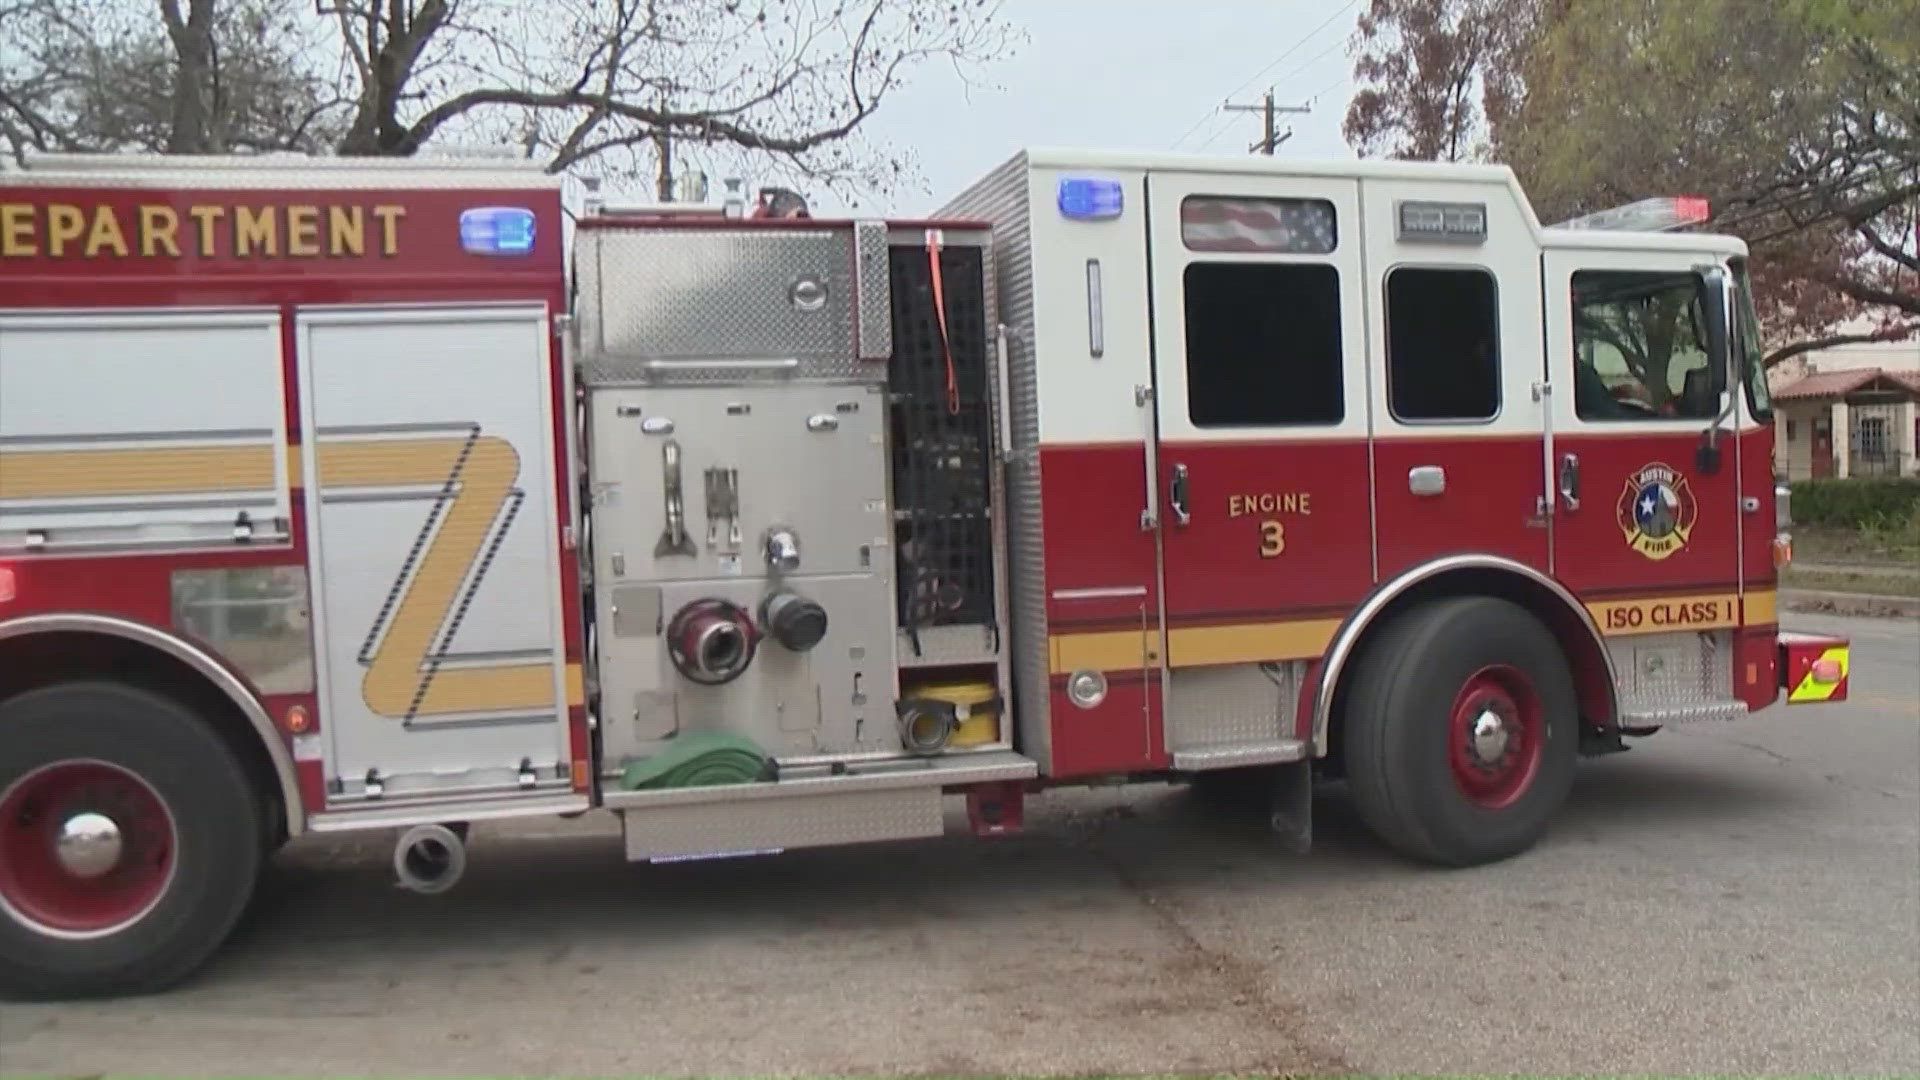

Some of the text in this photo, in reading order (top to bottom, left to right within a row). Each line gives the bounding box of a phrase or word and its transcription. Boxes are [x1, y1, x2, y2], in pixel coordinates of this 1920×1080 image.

[0, 204, 407, 257] EPARTMENT
[1640, 468, 1674, 484] AUSTIN
[1228, 493, 1312, 518] ENGINE
[1259, 520, 1285, 558] 3
[1643, 540, 1672, 553] FIRE
[1606, 605, 1643, 629] ISO
[1650, 601, 1718, 625] CLASS
